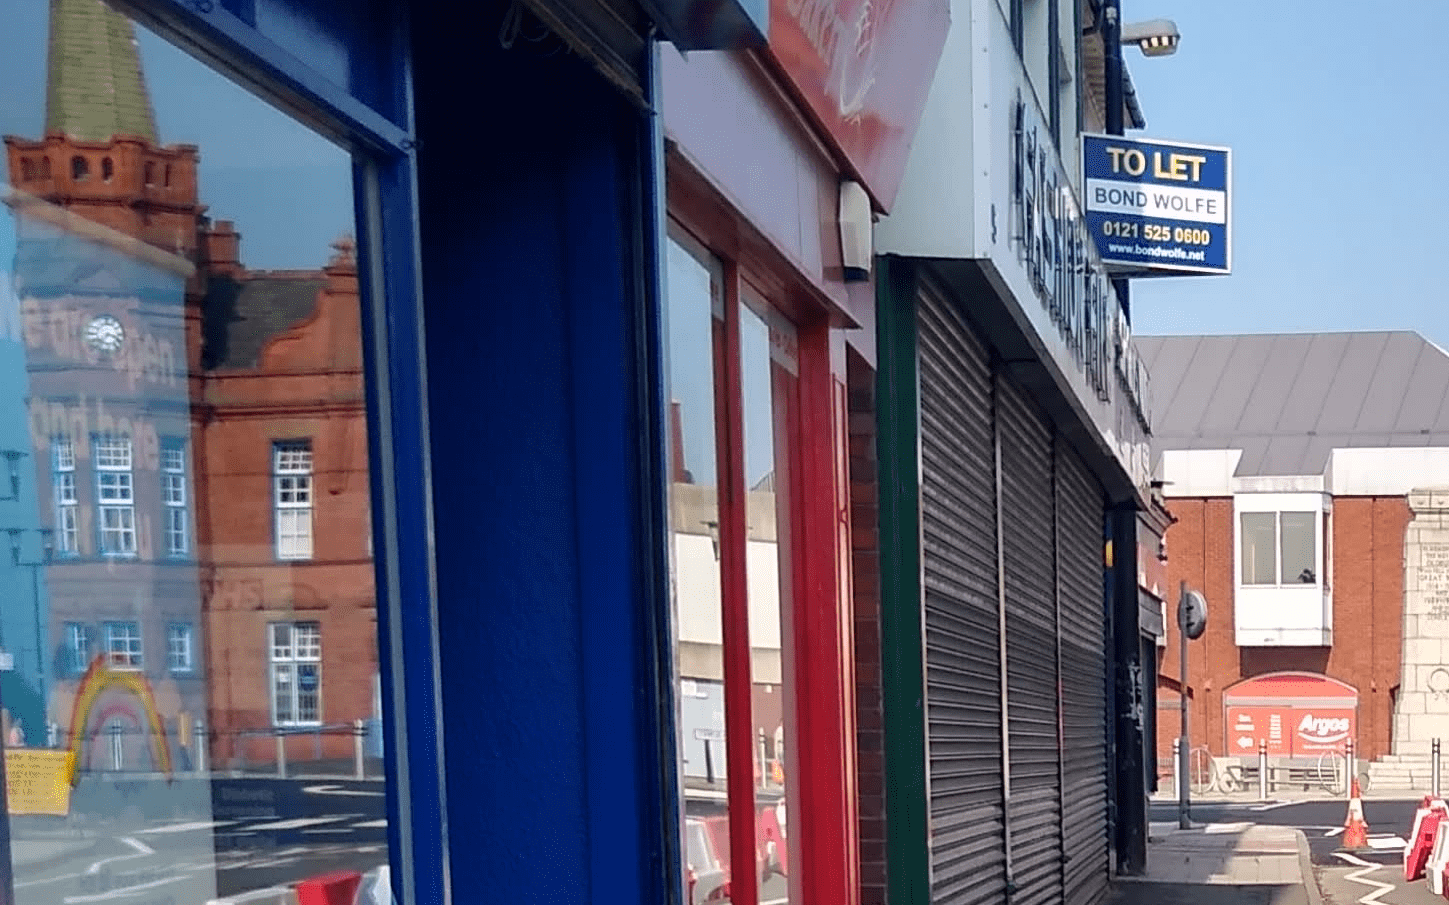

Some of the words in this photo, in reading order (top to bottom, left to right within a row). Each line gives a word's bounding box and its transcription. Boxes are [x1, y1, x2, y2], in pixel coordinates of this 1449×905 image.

[1106, 147, 1146, 176] TO
[1154, 152, 1206, 182] LET
[1095, 187, 1148, 208] BOND
[1153, 193, 1217, 214] WOLFE
[1103, 220, 1139, 238] 0121
[1144, 224, 1171, 241] 525
[1174, 227, 1210, 245] 0600
[1108, 243, 1205, 261] www.bondwolfe.net
[1299, 714, 1350, 735] Argos
